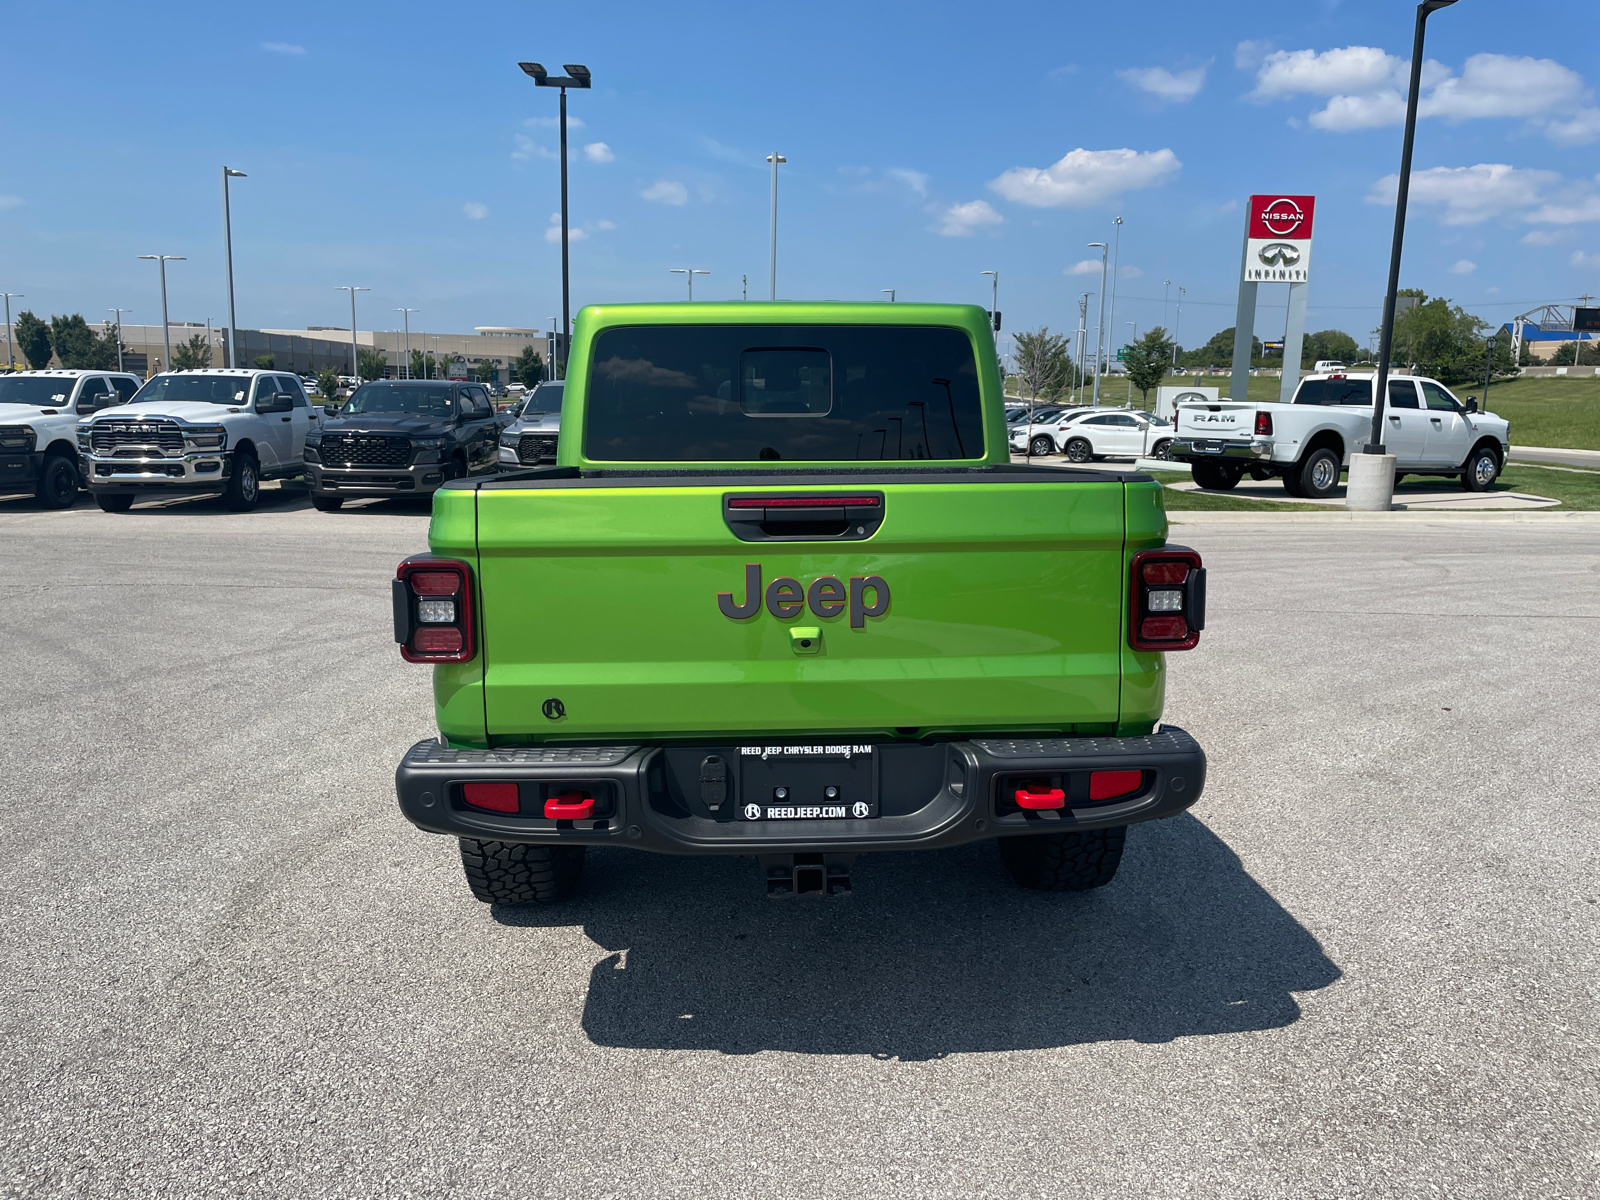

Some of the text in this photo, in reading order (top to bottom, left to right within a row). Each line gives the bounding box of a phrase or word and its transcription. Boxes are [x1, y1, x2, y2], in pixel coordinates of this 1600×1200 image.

[1248, 269, 1307, 280] INFINITI
[717, 563, 890, 628] Jeep
[741, 745, 872, 755] REED JEEP CHRYSLER DODGE RAM
[767, 807, 846, 819] REEDJEEP.COM
